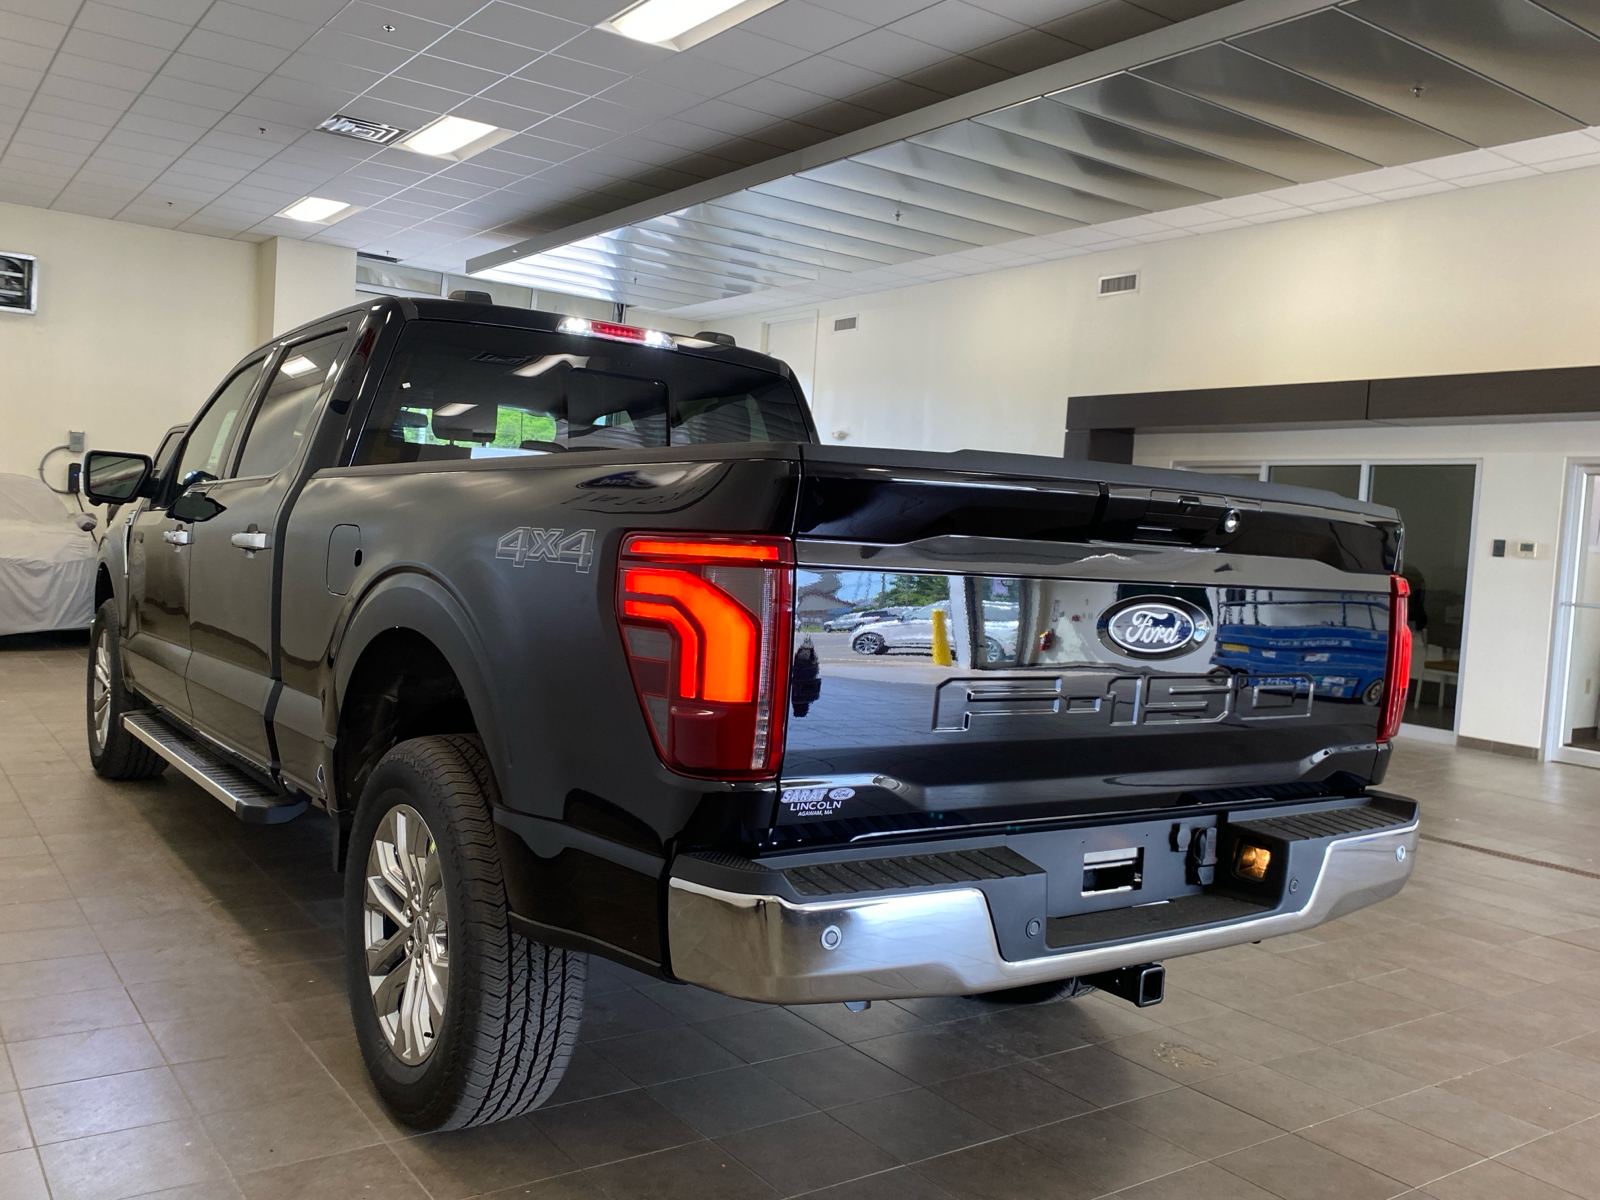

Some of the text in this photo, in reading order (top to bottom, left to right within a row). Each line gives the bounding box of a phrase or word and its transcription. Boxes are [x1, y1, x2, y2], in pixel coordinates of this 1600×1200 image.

[495, 526, 596, 574] 4X4
[1125, 610, 1181, 644] Ford
[932, 673, 1315, 733] F-150
[781, 789, 828, 803] SARAT
[790, 800, 842, 811] LINCOLN
